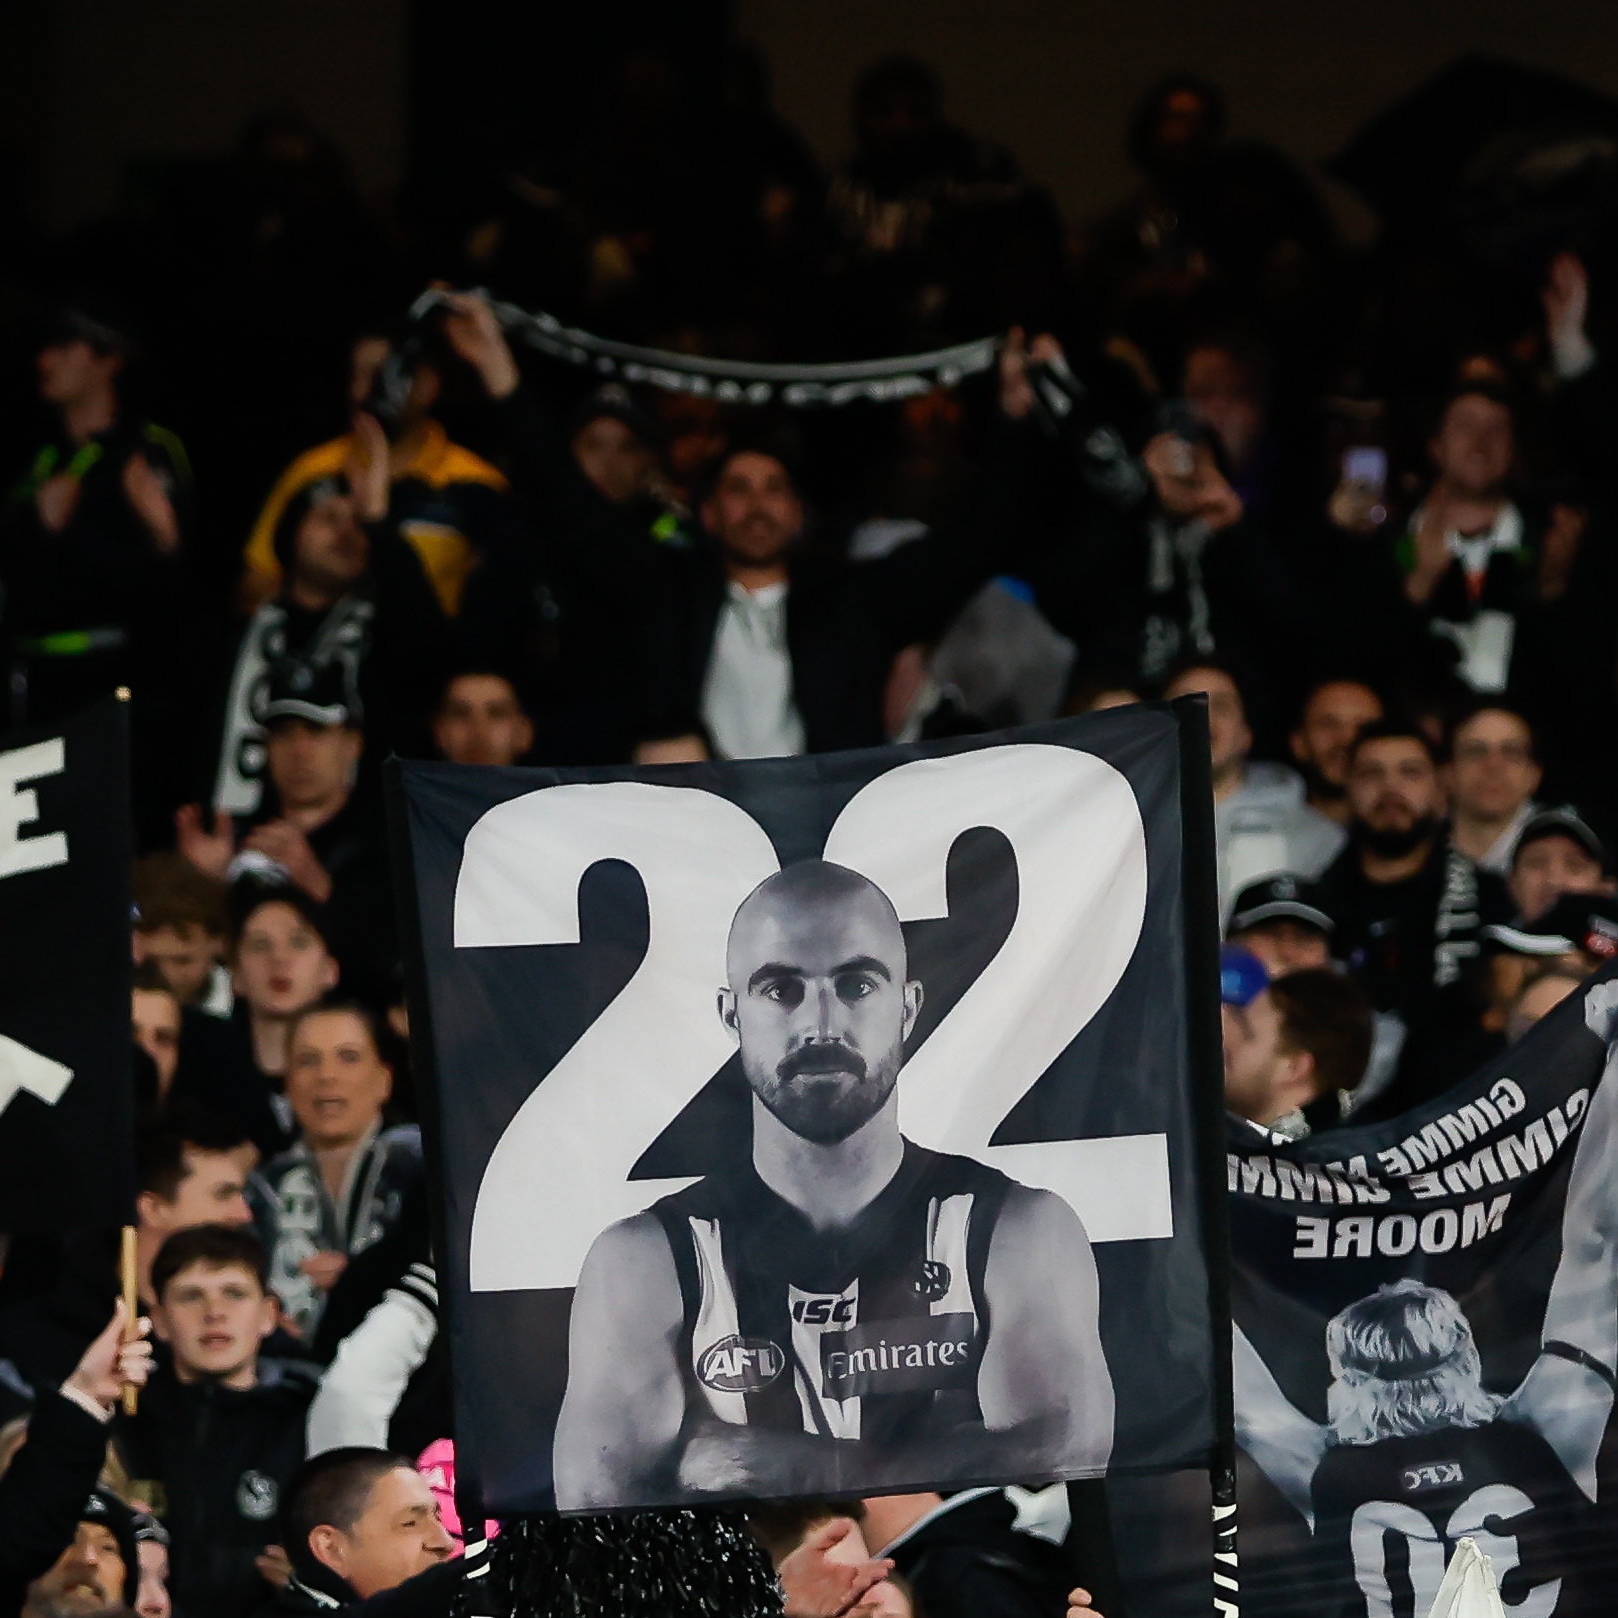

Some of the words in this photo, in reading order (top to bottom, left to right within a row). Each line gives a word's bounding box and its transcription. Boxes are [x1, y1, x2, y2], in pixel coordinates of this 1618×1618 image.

[453, 743, 1175, 1293] 22
[791, 1298, 857, 1325] ISC
[703, 1347, 779, 1382] AFL
[827, 1339, 969, 1380] Emirates
